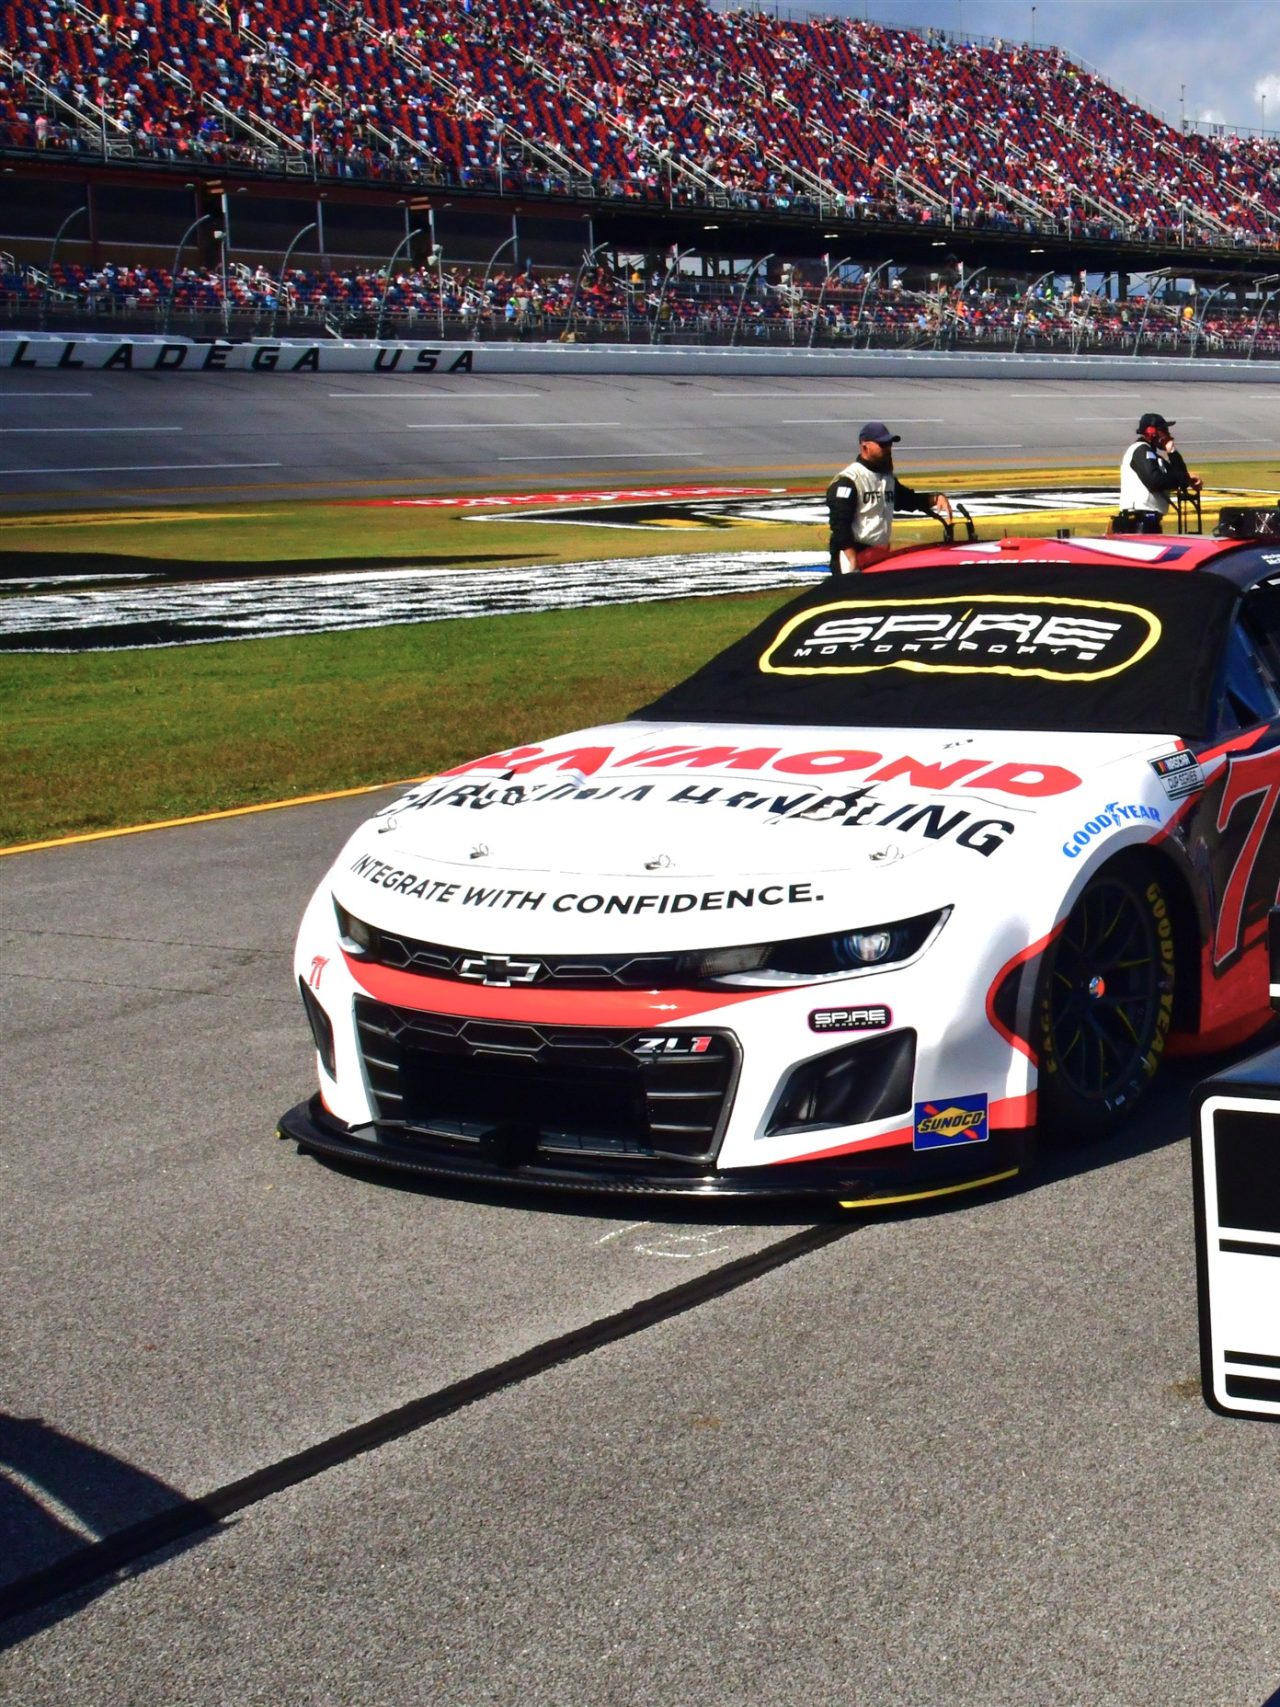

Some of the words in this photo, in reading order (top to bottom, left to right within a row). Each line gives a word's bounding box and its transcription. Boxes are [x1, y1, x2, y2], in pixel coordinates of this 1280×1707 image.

[374, 348, 473, 372] USA
[438, 745, 1083, 798] RAYMOND
[1167, 753, 1191, 771] NASCAR
[1062, 802, 1161, 858] GOODYEAR
[350, 852, 461, 904] INTEGRATE
[463, 886, 547, 911] WITH
[551, 882, 825, 915] CONFIDENCE.
[634, 1036, 713, 1054] ZL1
[920, 1111, 984, 1132] SUNOCO
